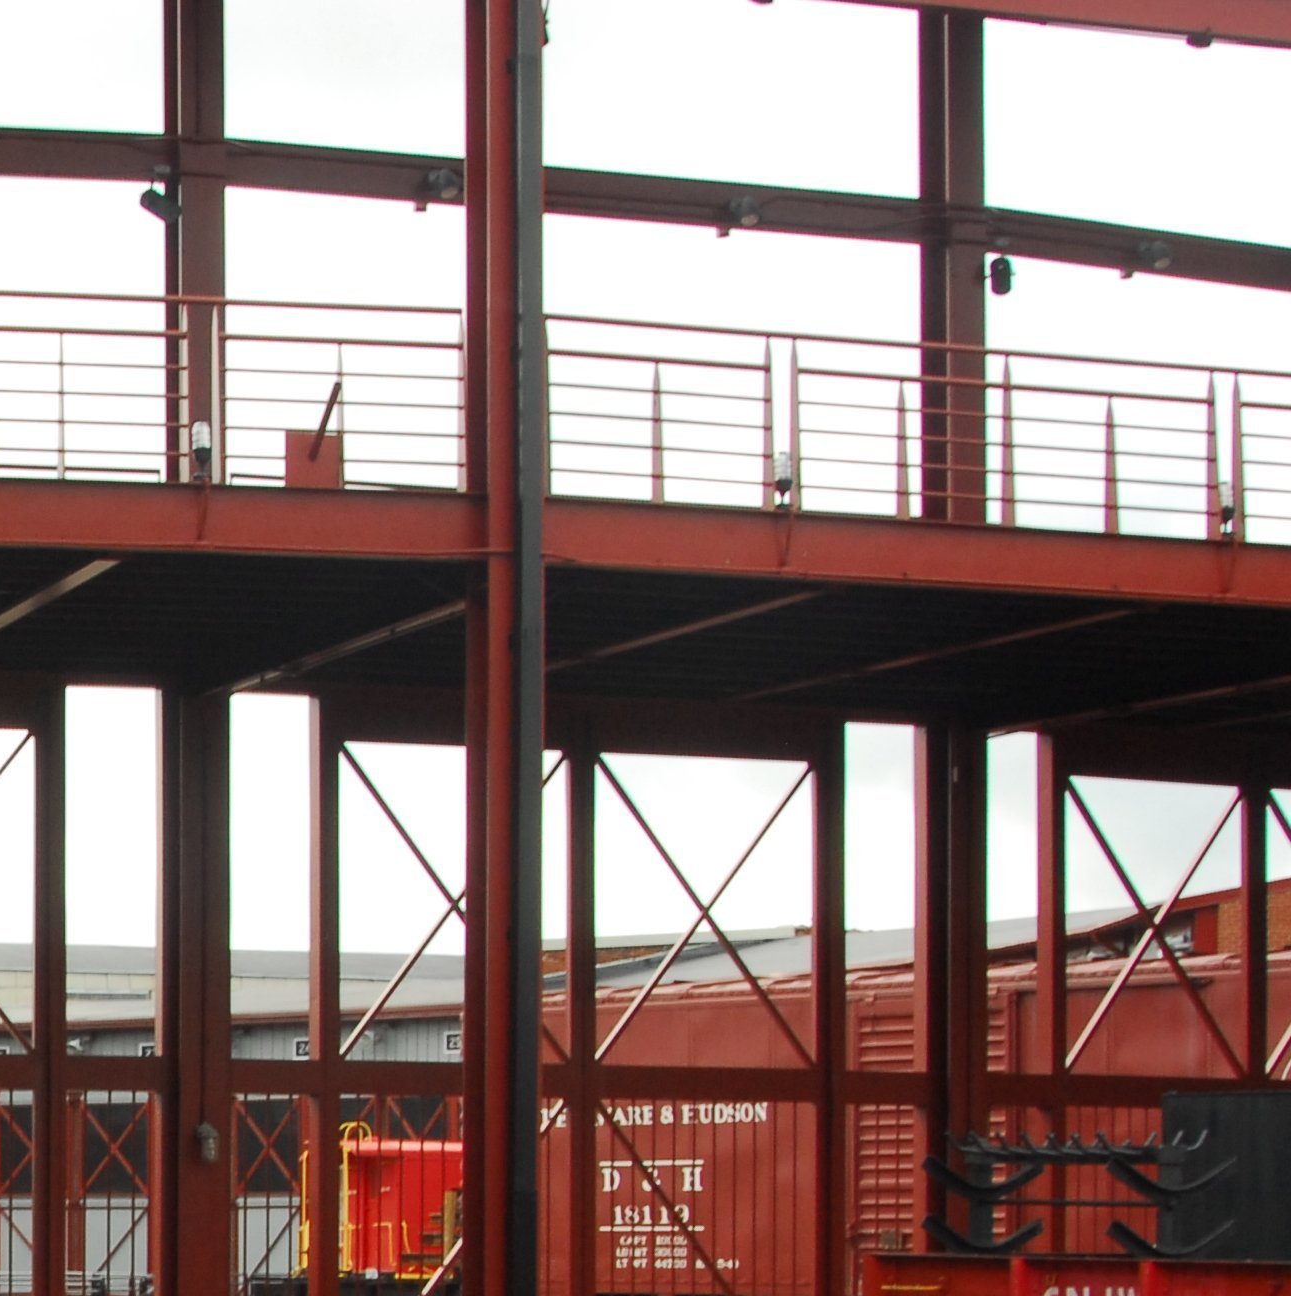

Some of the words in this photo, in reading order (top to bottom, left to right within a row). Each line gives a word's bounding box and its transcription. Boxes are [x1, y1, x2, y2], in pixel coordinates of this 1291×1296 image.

[660, 1105, 674, 1125] &
[682, 1102, 768, 1125] HUDSON
[601, 1168, 621, 1192] D
[682, 1167, 704, 1192] H
